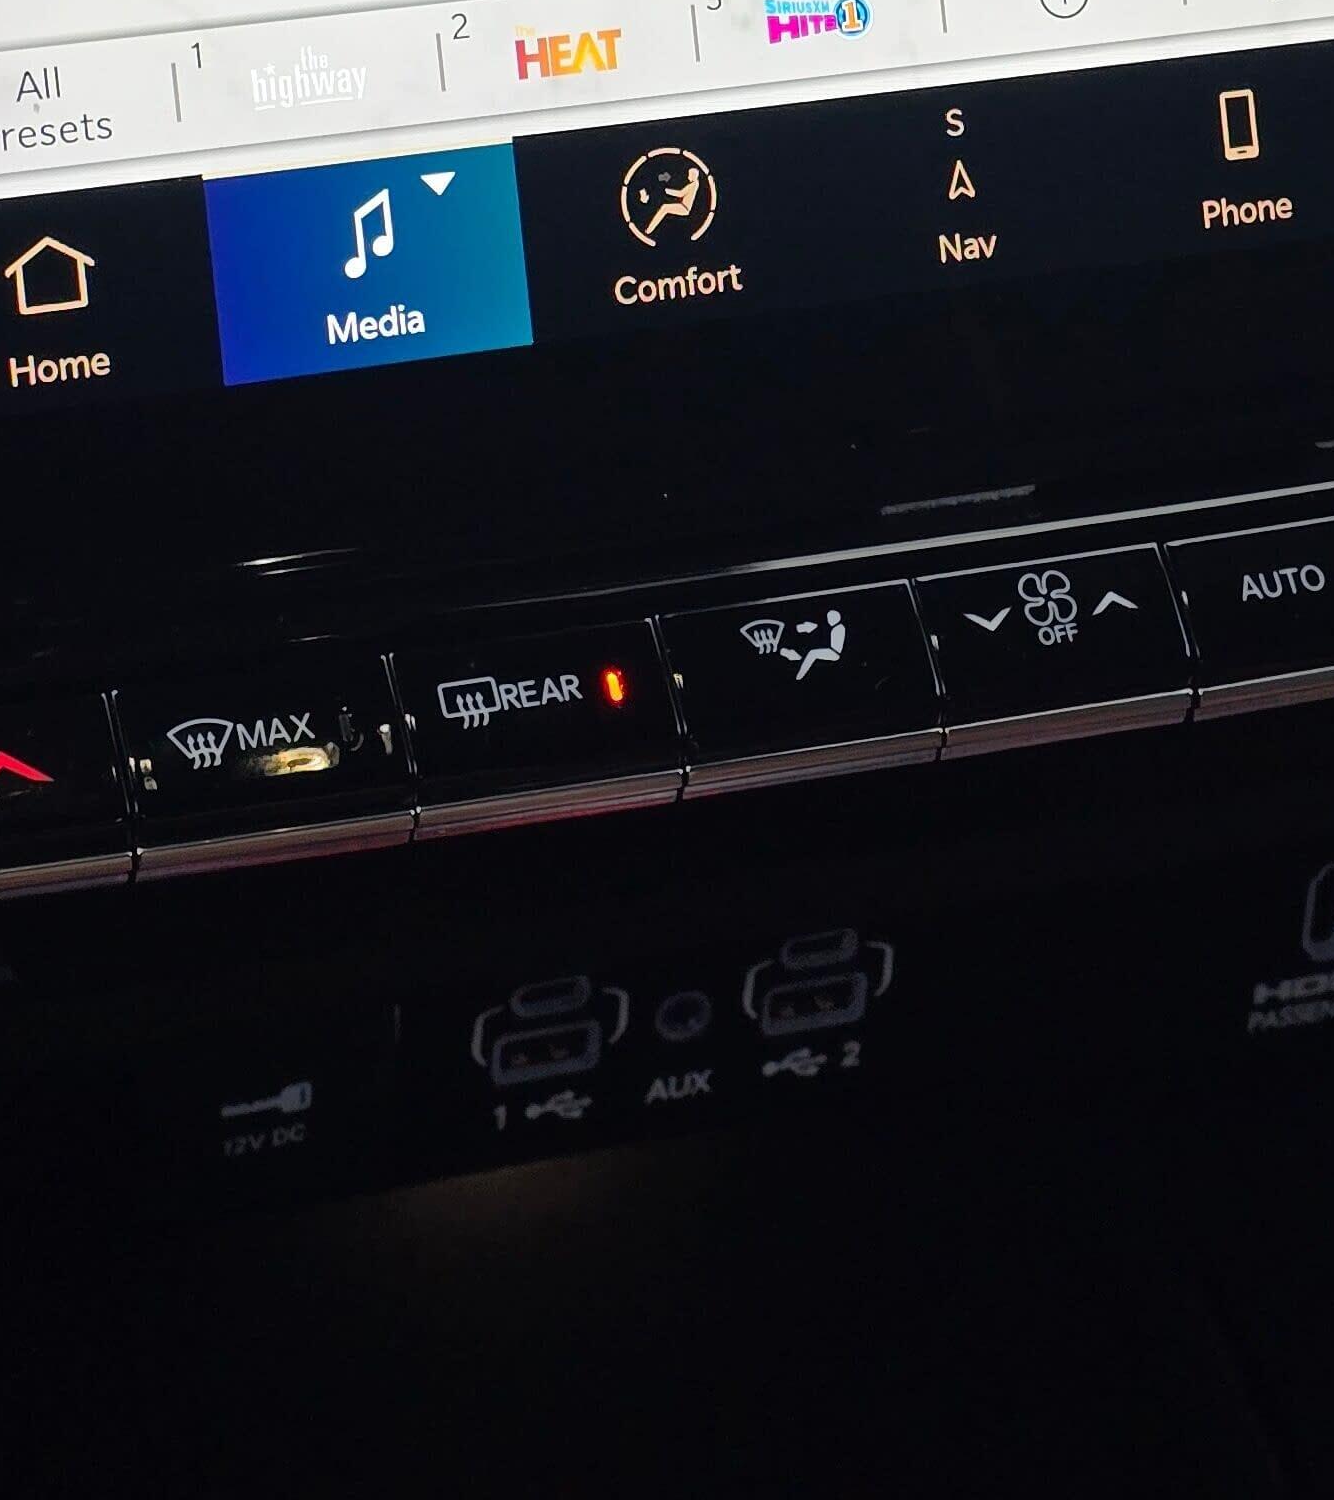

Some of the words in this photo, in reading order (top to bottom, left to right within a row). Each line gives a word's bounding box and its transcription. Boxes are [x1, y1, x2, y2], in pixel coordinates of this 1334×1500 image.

[452, 14, 470, 40] 2
[767, 15, 837, 44] HITS
[191, 43, 204, 68] 1
[300, 46, 329, 70] the
[515, 28, 621, 81] HEAT
[16, 67, 62, 104] All
[251, 64, 368, 108] highway
[946, 109, 965, 137] S
[1203, 196, 1293, 229] Phone
[939, 232, 998, 264] Nav
[615, 264, 743, 305] Comfort
[327, 304, 425, 345] Media
[9, 350, 111, 388] Home
[1242, 565, 1325, 602] AUTO
[1038, 622, 1078, 645] OFF
[499, 675, 583, 711] REAR
[237, 712, 316, 750] MAX
[841, 1041, 862, 1068] 2
[645, 1069, 713, 1104] AUX
[494, 1105, 507, 1132] 1
